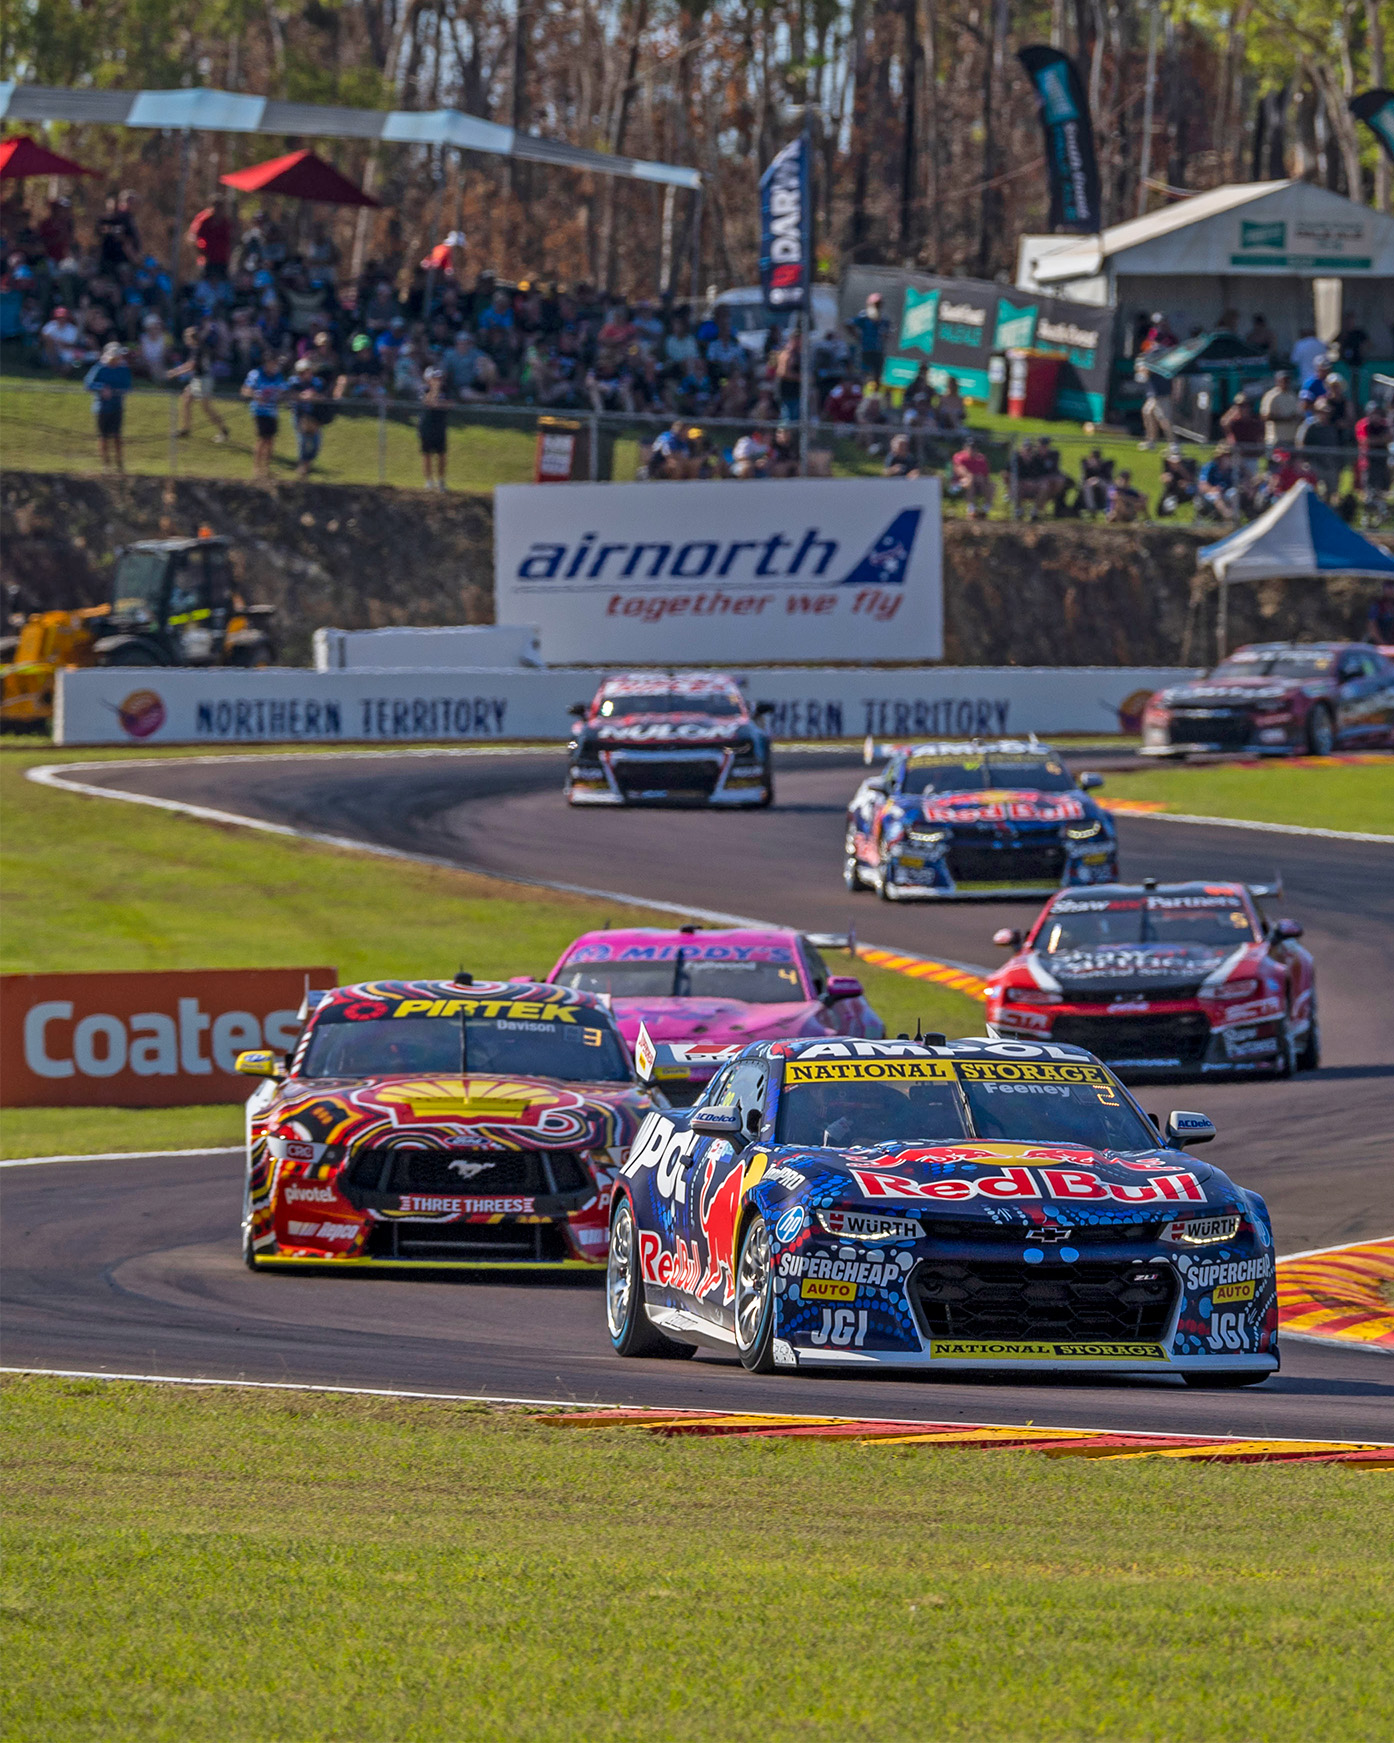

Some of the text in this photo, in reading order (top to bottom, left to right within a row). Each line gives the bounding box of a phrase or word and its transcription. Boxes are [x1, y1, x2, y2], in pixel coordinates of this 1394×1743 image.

[517, 529, 839, 583] airnorth
[606, 588, 904, 623] together we fly
[195, 696, 508, 735] NORTHERN TERRITORY
[771, 696, 1010, 735] HERN TERRITORY
[925, 800, 1085, 823] Red Bull
[393, 1000, 579, 1024] PIRTEK
[497, 1018, 556, 1034] Davison
[24, 997, 302, 1078] Coates
[584, 1027, 602, 1048] 3
[798, 1041, 1090, 1062] AMPOL
[791, 1062, 1103, 1083] NATIONAL STORAGE
[982, 1082, 1071, 1098] Feeney
[694, 1112, 737, 1122] ACDelco
[287, 1145, 313, 1158] CRC
[850, 1167, 1208, 1203] Red Bull
[412, 1197, 523, 1213] THREE THREES
[316, 1221, 360, 1241] Repco
[778, 1207, 802, 1240] hp
[640, 1231, 680, 1288] Red
[778, 1254, 900, 1287] SUPERCHEAP
[1187, 1252, 1272, 1291] SUPERCHEAP
[806, 1279, 851, 1296] AUTO
[1217, 1284, 1251, 1299] AUTO
[935, 1343, 1161, 1357] NATIONAL STORAGE
